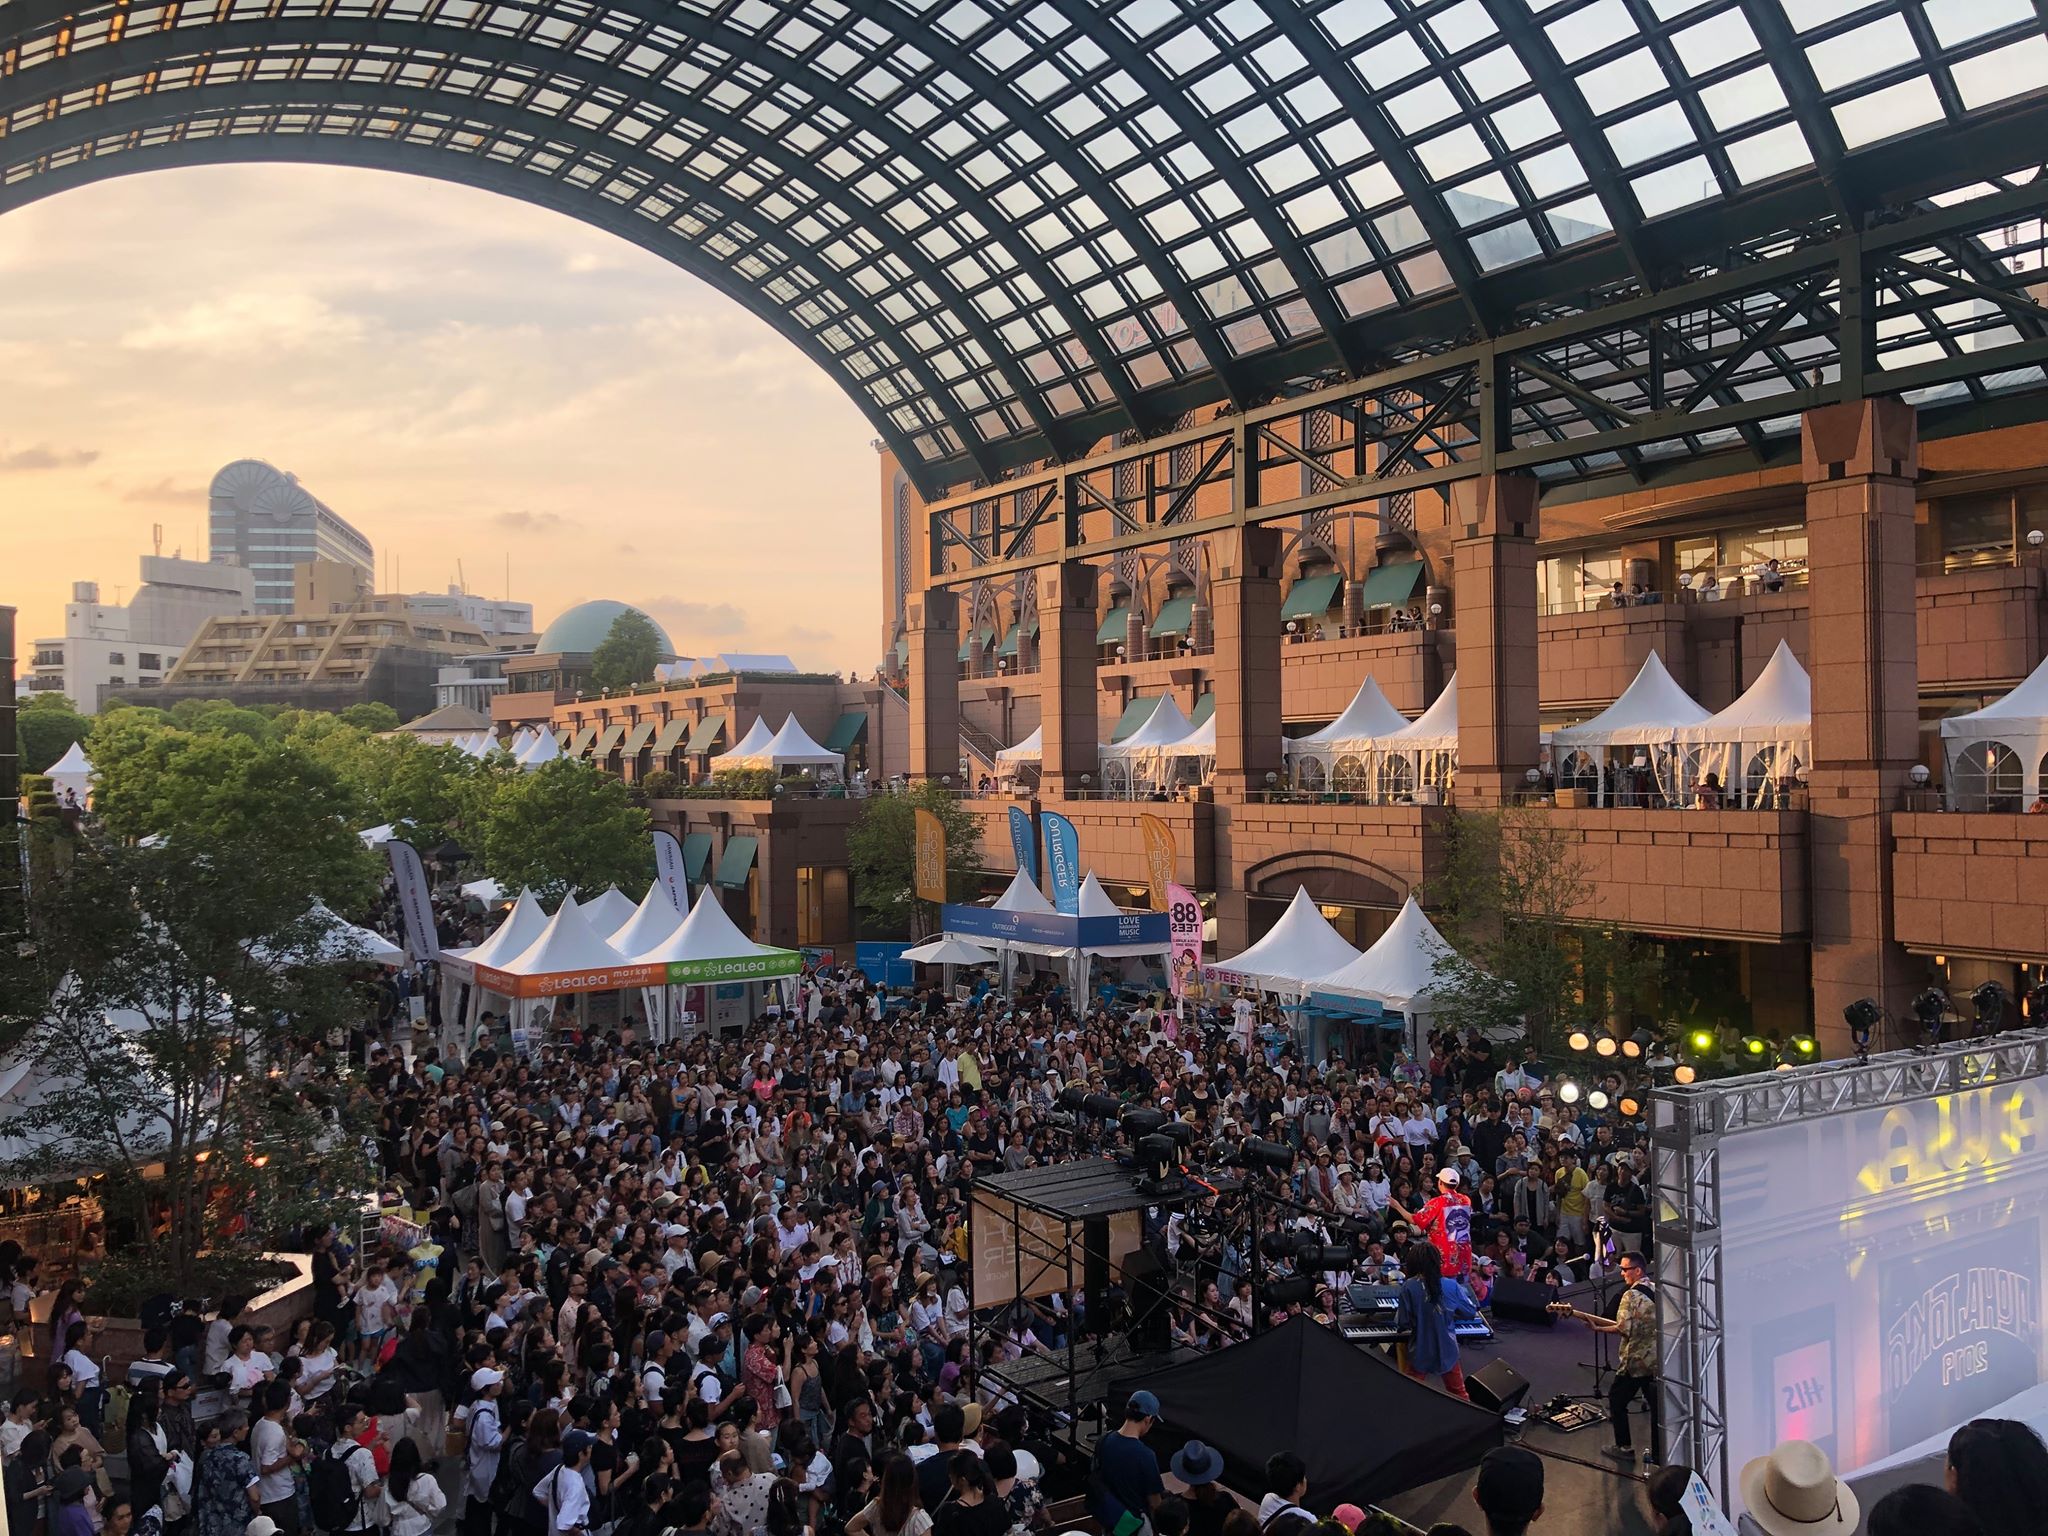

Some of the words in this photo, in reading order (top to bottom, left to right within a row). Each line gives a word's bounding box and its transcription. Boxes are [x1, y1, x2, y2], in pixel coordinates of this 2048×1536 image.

[1119, 917, 1140, 925] LOVE
[613, 967, 652, 978] market
[1205, 968, 1216, 980] 88
[1218, 971, 1241, 984] TEES
